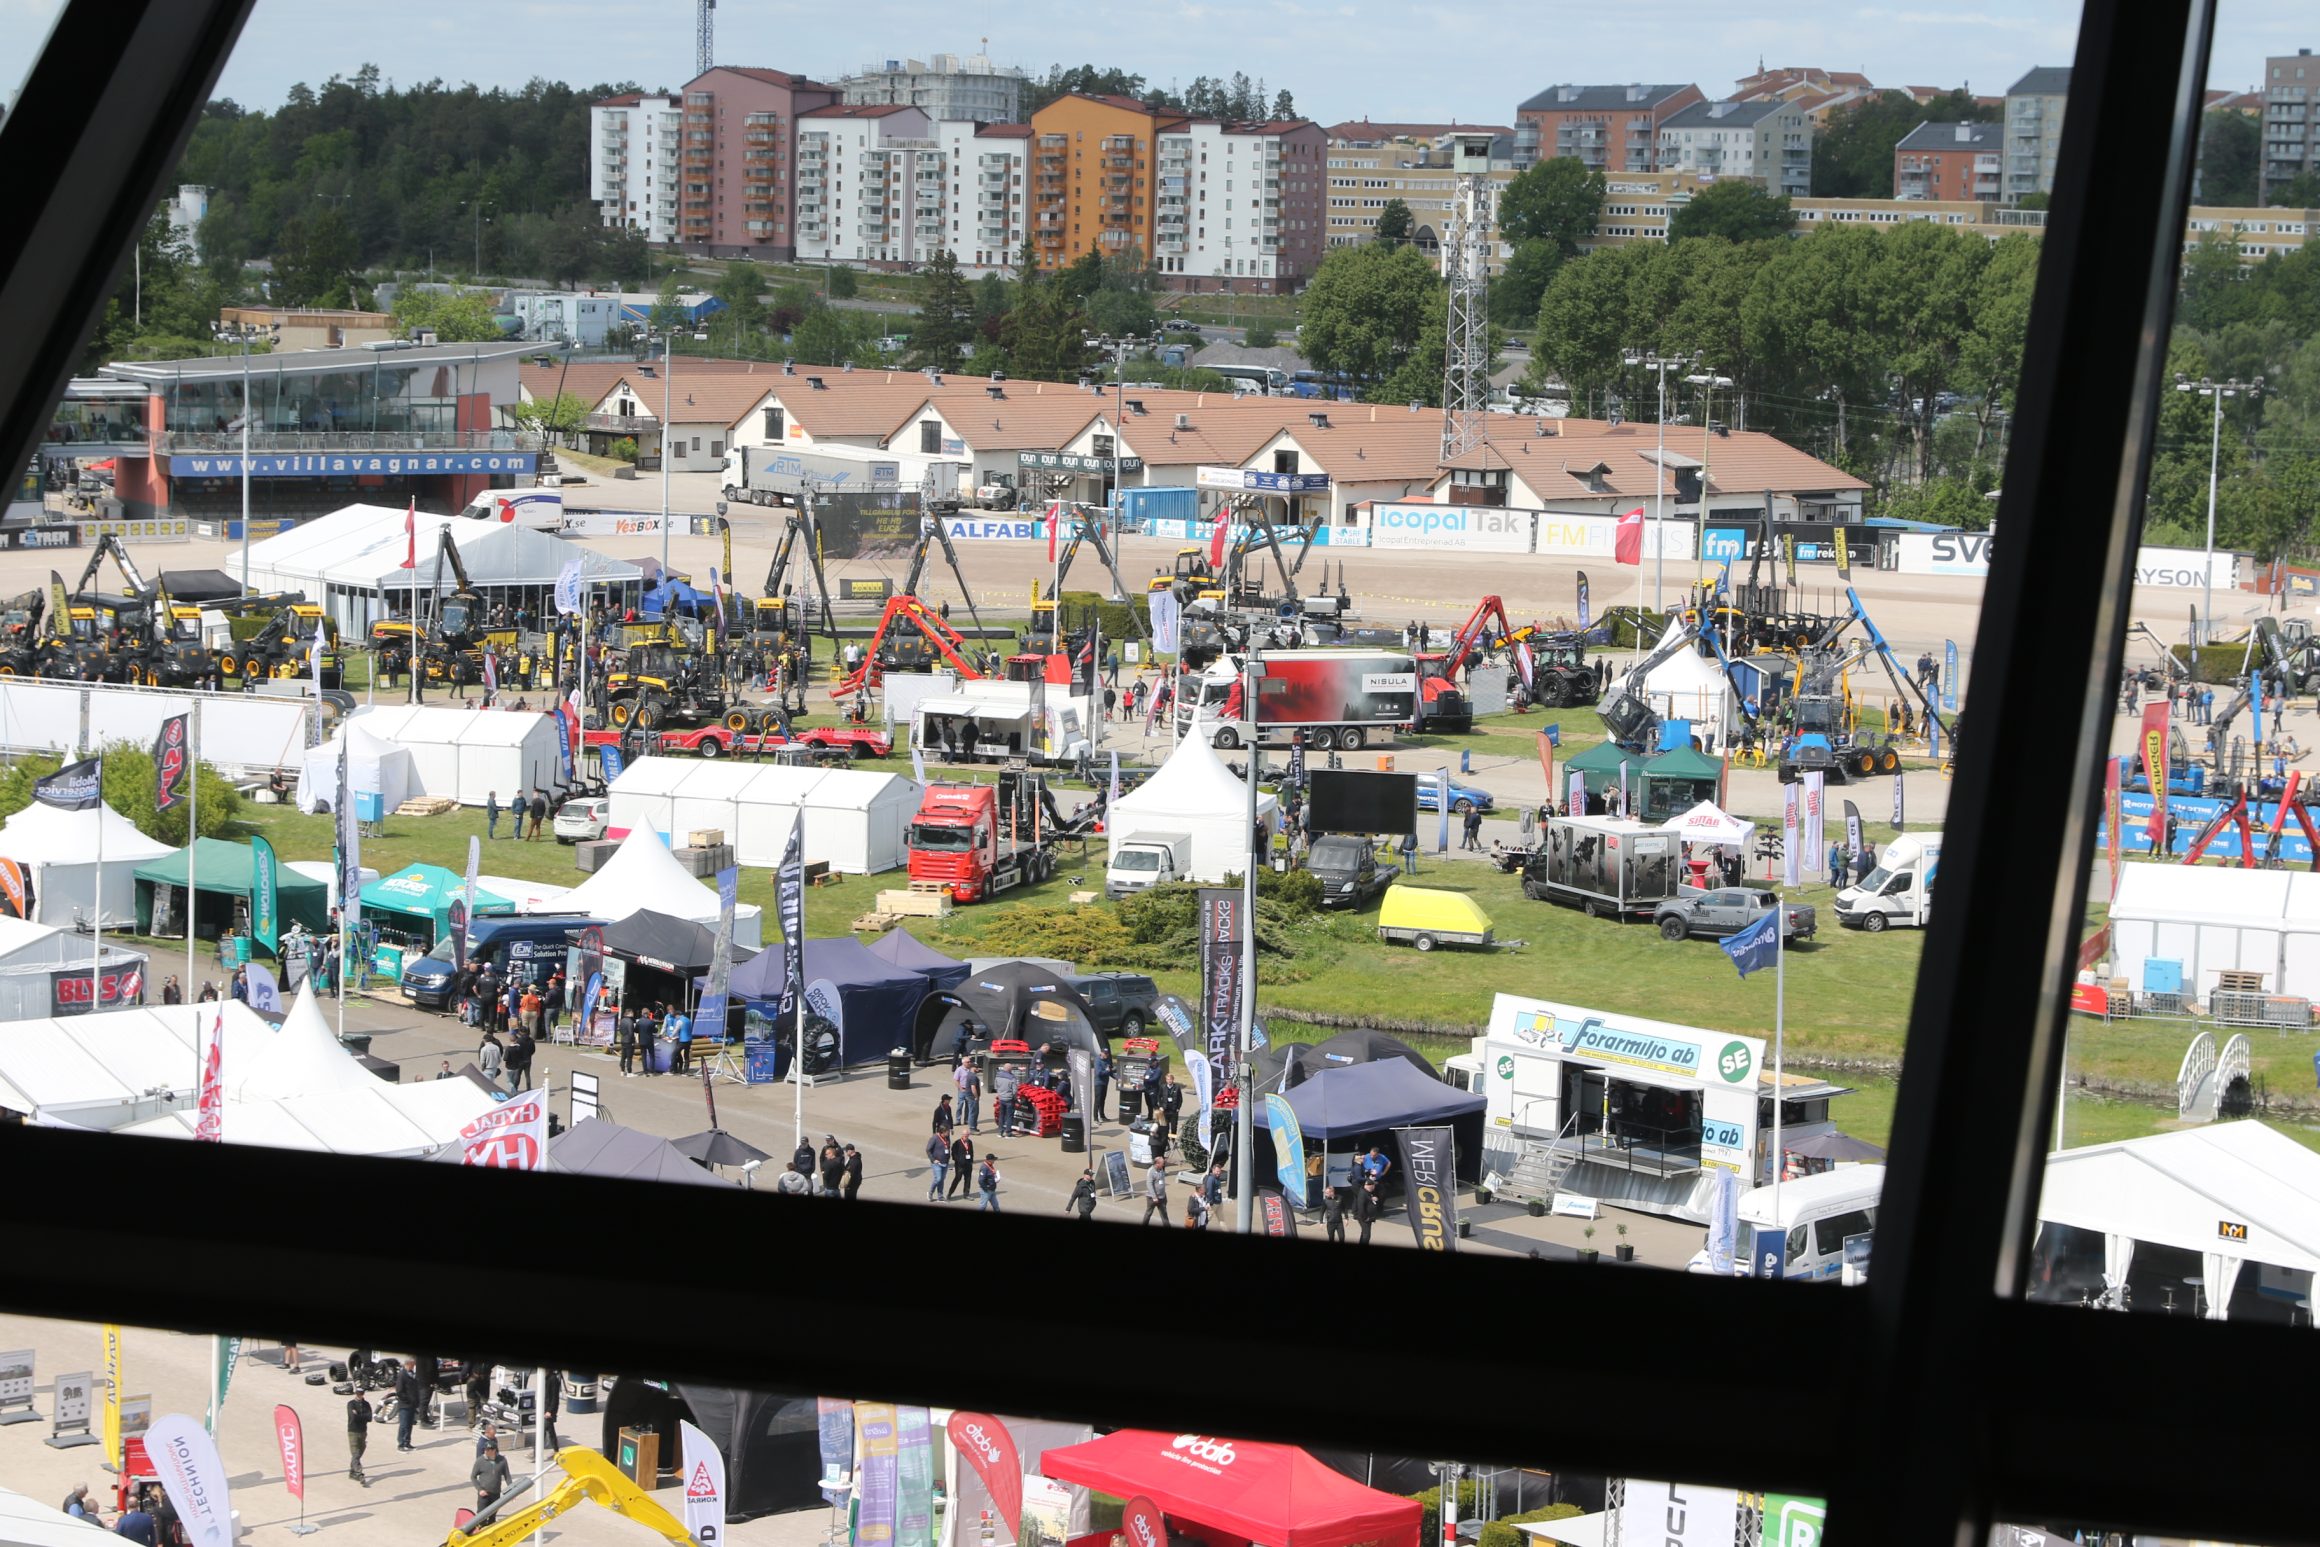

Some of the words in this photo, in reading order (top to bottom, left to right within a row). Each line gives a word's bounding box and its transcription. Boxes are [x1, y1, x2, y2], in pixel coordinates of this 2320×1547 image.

[191, 456, 524, 473] www.villavagnar.com
[615, 519, 675, 535] YesBOX.e
[1380, 506, 1468, 535] icopal
[1471, 509, 1520, 534] Tak
[950, 523, 1032, 539] ALFAB
[1706, 531, 1741, 557] fm
[1799, 548, 1815, 558] fm
[1816, 548, 1857, 559] rekm
[2132, 568, 2208, 588] AYSON
[1688, 815, 1720, 826] SITTAB
[511, 943, 532, 957] CEJN
[533, 950, 557, 958] Solution
[1214, 955, 1233, 1018] TRACKS
[1209, 1018, 1228, 1080] LARK
[1561, 1018, 1668, 1060] Förarmiljö
[1671, 1047, 1696, 1065] ab
[1498, 1060, 1514, 1076] SE
[1721, 1052, 1749, 1074] SE
[1498, 1118, 1511, 1126] Inter
[1718, 1129, 1740, 1146] ab
[1189, 1437, 1236, 1466] dafo
[1160, 1449, 1181, 1462] vehicle
[1191, 1459, 1222, 1476] protection
